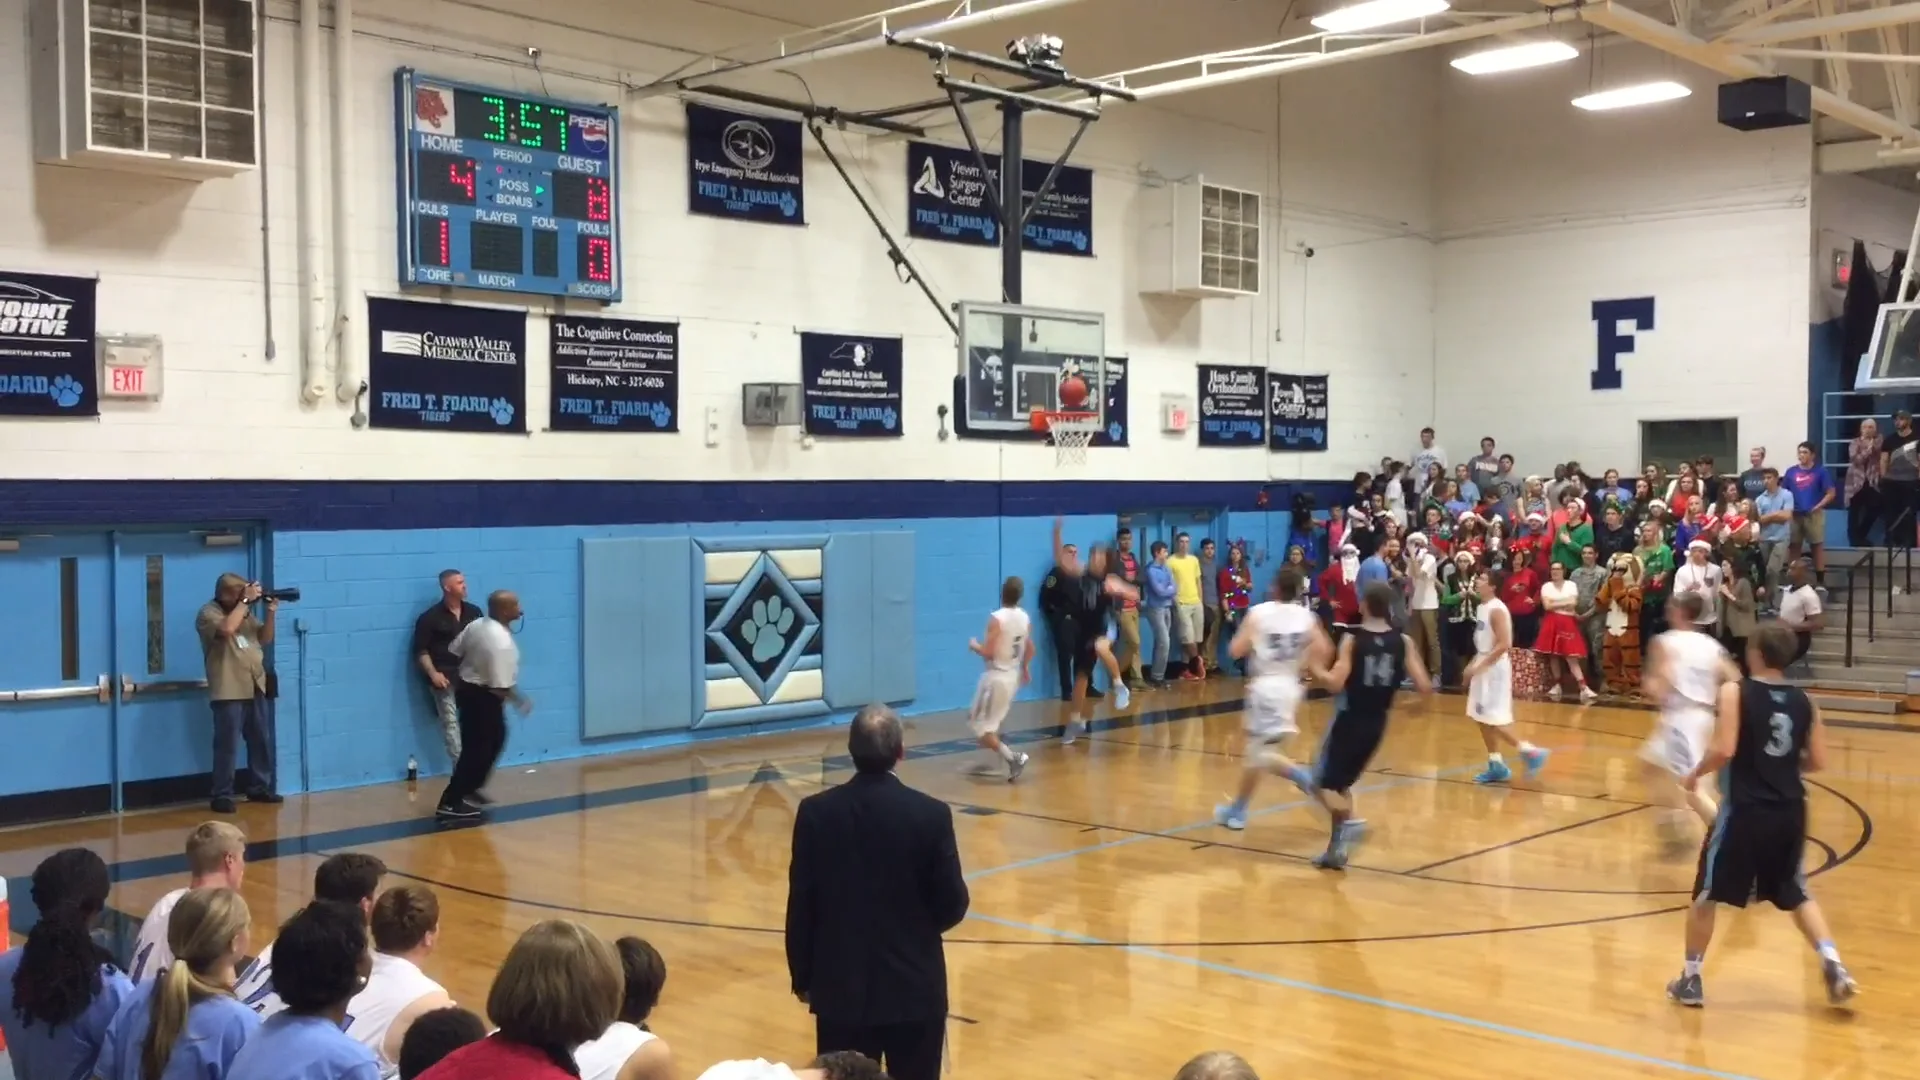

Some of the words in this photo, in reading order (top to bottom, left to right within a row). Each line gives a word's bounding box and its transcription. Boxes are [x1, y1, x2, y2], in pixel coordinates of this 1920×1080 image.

[483, 96, 566, 151] 3:57
[569, 113, 608, 132] PEPSI
[421, 135, 463, 153] HOME
[493, 147, 533, 164] PERIOD
[558, 155, 602, 174] GUEST
[449, 159, 475, 198] 4
[711, 162, 745, 180] Emergency
[745, 168, 769, 181] Medical
[499, 179, 530, 193] POSS
[699, 181, 727, 198] FRED
[729, 185, 741, 200] T.
[743, 188, 780, 204] FOARD
[950, 174, 986, 196] Surgery
[496, 193, 533, 208] BONUS
[949, 190, 983, 208] Center
[476, 208, 518, 224] PLAYER
[531, 215, 559, 230] FOUL
[916, 208, 940, 225] FRED
[952, 214, 983, 230] FOARD
[577, 222, 610, 237] FOULS
[439, 219, 450, 267] 1
[588, 238, 610, 281] 0
[478, 273, 516, 288] MATCH
[576, 283, 612, 297] SCORE
[0, 300, 72, 319] OUNT
[0, 317, 68, 336] OTIVE
[556, 323, 575, 338] The
[577, 325, 621, 342] Cognitive
[623, 328, 674, 344] Connection
[474, 335, 511, 351] VALLEY
[556, 345, 588, 355] Addiction
[1591, 296, 1655, 391] F
[423, 346, 475, 361] MEDICAL
[474, 349, 517, 364] CENTER
[113, 369, 144, 392] EXIT
[566, 373, 604, 388] Hickory,
[605, 374, 620, 386] NC
[381, 391, 421, 409] FRED
[425, 394, 438, 410] T.
[442, 395, 489, 412] FOARD
[560, 397, 592, 414] FRED
[595, 399, 608, 415] T.
[611, 400, 650, 416] FOARD
[812, 404, 836, 419] FRED
[851, 406, 882, 420] FOARD
[1763, 711, 1794, 757] 3
